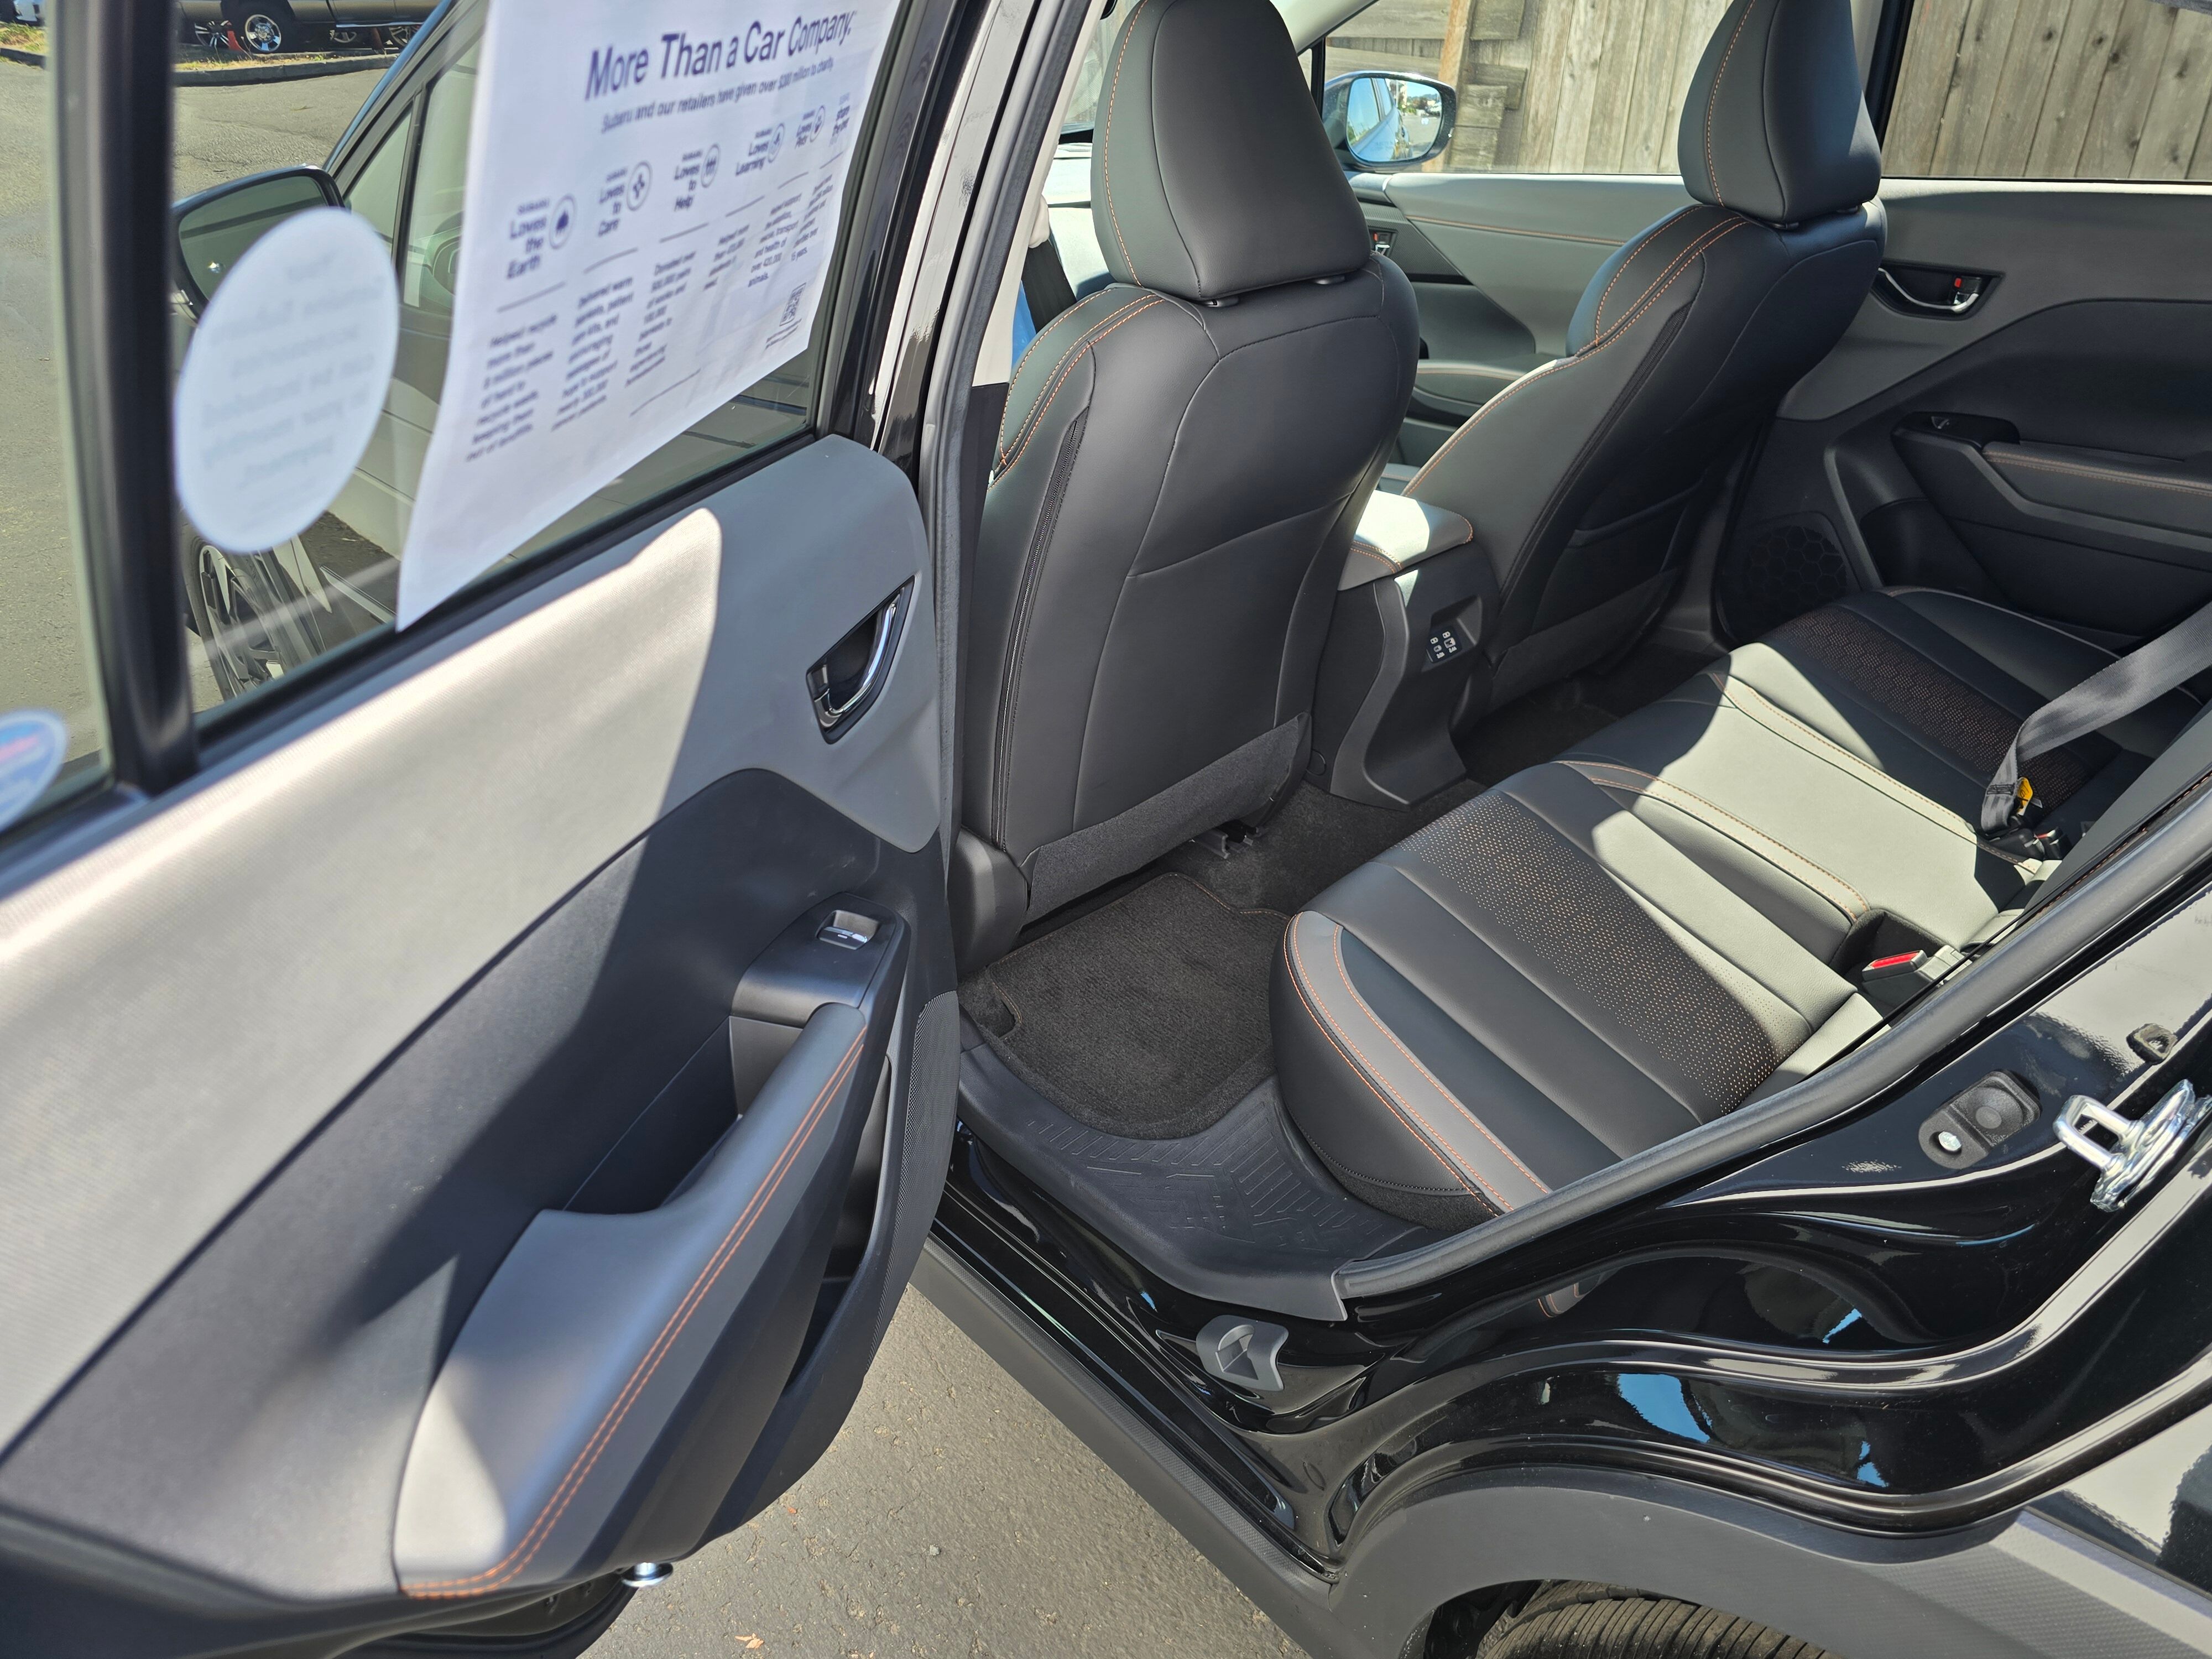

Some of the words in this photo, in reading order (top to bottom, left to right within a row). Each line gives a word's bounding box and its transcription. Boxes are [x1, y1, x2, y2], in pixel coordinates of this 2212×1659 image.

[585, 44, 649, 101] More
[660, 31, 722, 79] Than
[726, 35, 739, 69] a
[744, 20, 784, 64] Car
[787, 11, 854, 57] Company.
[636, 101, 655, 120] and
[657, 101, 676, 116] our
[677, 93, 715, 112] retailers
[717, 87, 734, 105] have
[735, 82, 757, 103] given
[759, 79, 776, 93] over
[748, 142, 769, 156] Loves
[674, 164, 700, 180] Loves
[735, 156, 766, 176] Learning
[688, 179, 697, 191] to
[599, 184, 624, 205] Loves
[674, 195, 695, 212] Help
[613, 201, 621, 215] to
[510, 218, 547, 239] Loves
[598, 218, 620, 237] Care
[525, 237, 544, 253] the
[507, 254, 542, 280] Earth
[605, 313, 619, 329] and
